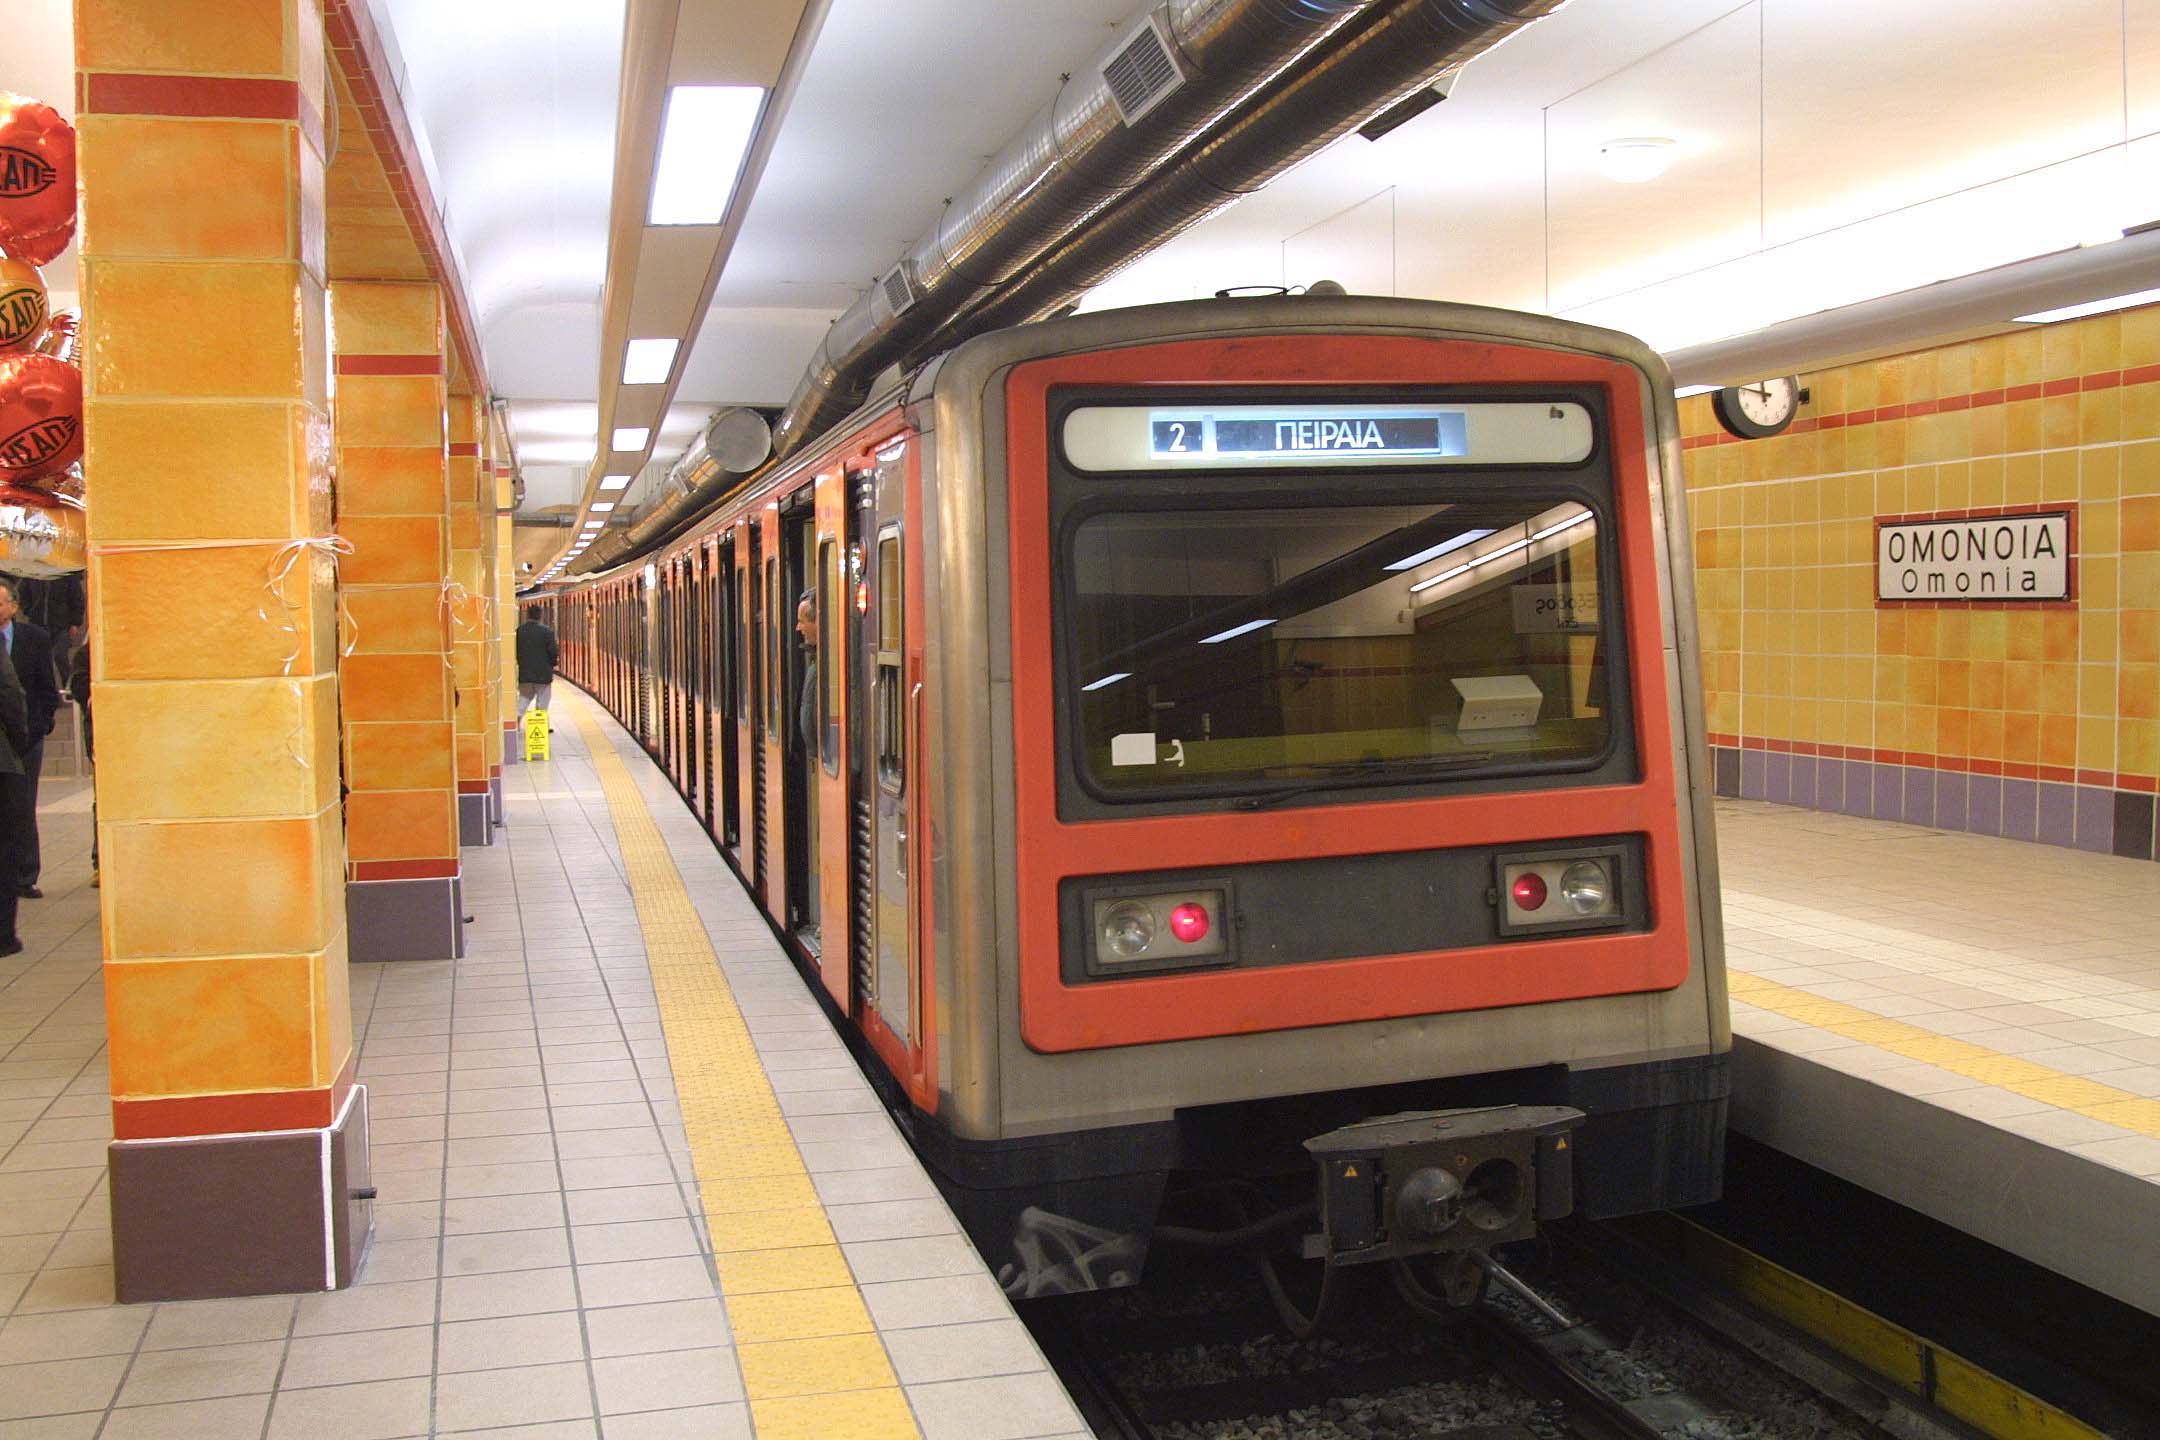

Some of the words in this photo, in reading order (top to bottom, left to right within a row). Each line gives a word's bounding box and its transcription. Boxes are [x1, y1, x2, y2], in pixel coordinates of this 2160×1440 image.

[0, 152, 40, 191] ΑΠ
[1168, 422, 1187, 453] 2
[1274, 420, 1385, 450] ΠΕΙΡΑΙΑ
[1888, 523, 2056, 564] ΟΜΟΝΟΙΑ
[1901, 566, 2037, 593] Omonia
